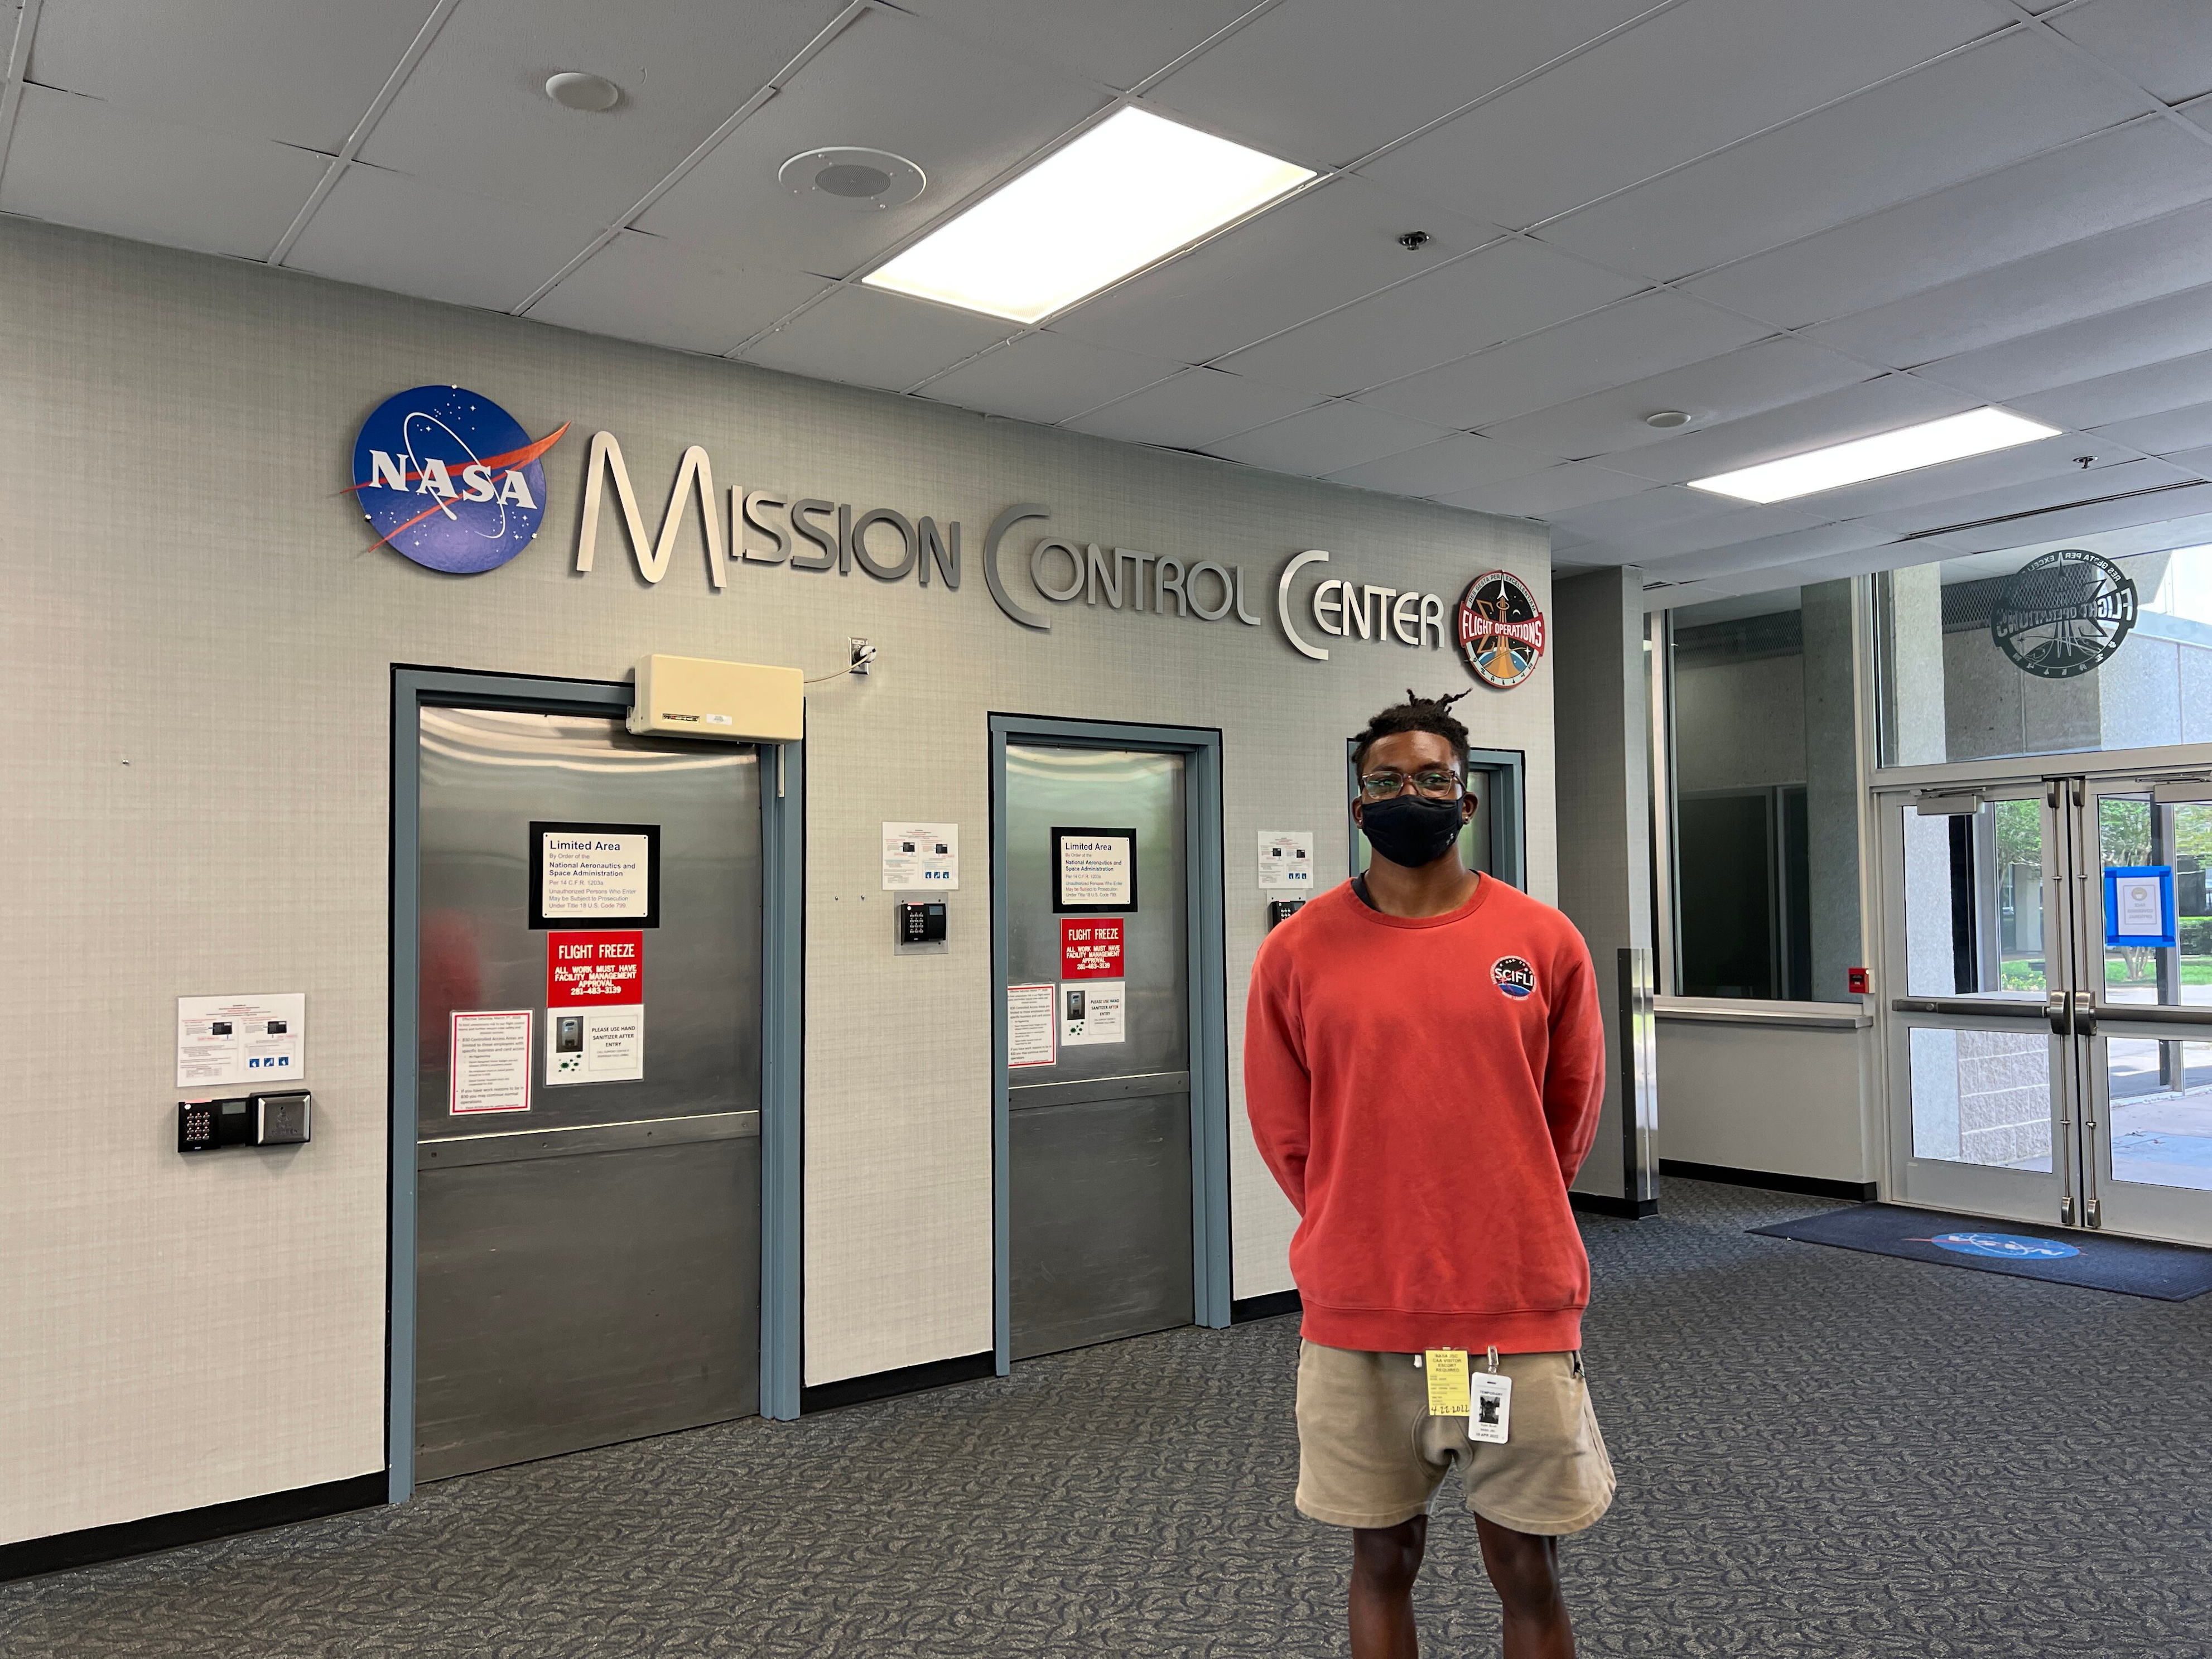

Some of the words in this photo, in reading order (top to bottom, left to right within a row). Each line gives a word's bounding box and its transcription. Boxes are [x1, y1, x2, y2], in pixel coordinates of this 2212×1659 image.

[369, 450, 537, 509] NASA
[1476, 577, 1490, 591] GESTA
[1506, 575, 1535, 611] EXCELLENTIAM
[1462, 610, 1493, 639] FLIGHT
[1495, 620, 1542, 647] OPERATIONS
[550, 840, 591, 850] Limited
[595, 842, 620, 850] Area
[1068, 929, 1091, 941] FLIGHT
[1095, 928, 1119, 940] FREEZE
[558, 944, 594, 959] FLIGHT
[599, 943, 635, 958] FREEZE
[555, 966, 568, 975] ALL
[572, 965, 592, 974] WORK
[596, 964, 616, 973] MUST
[619, 964, 637, 972] HAVE
[555, 973, 585, 982] FACILITY
[589, 971, 637, 980] MANAGEMENT
[578, 980, 615, 988] APPROVAL
